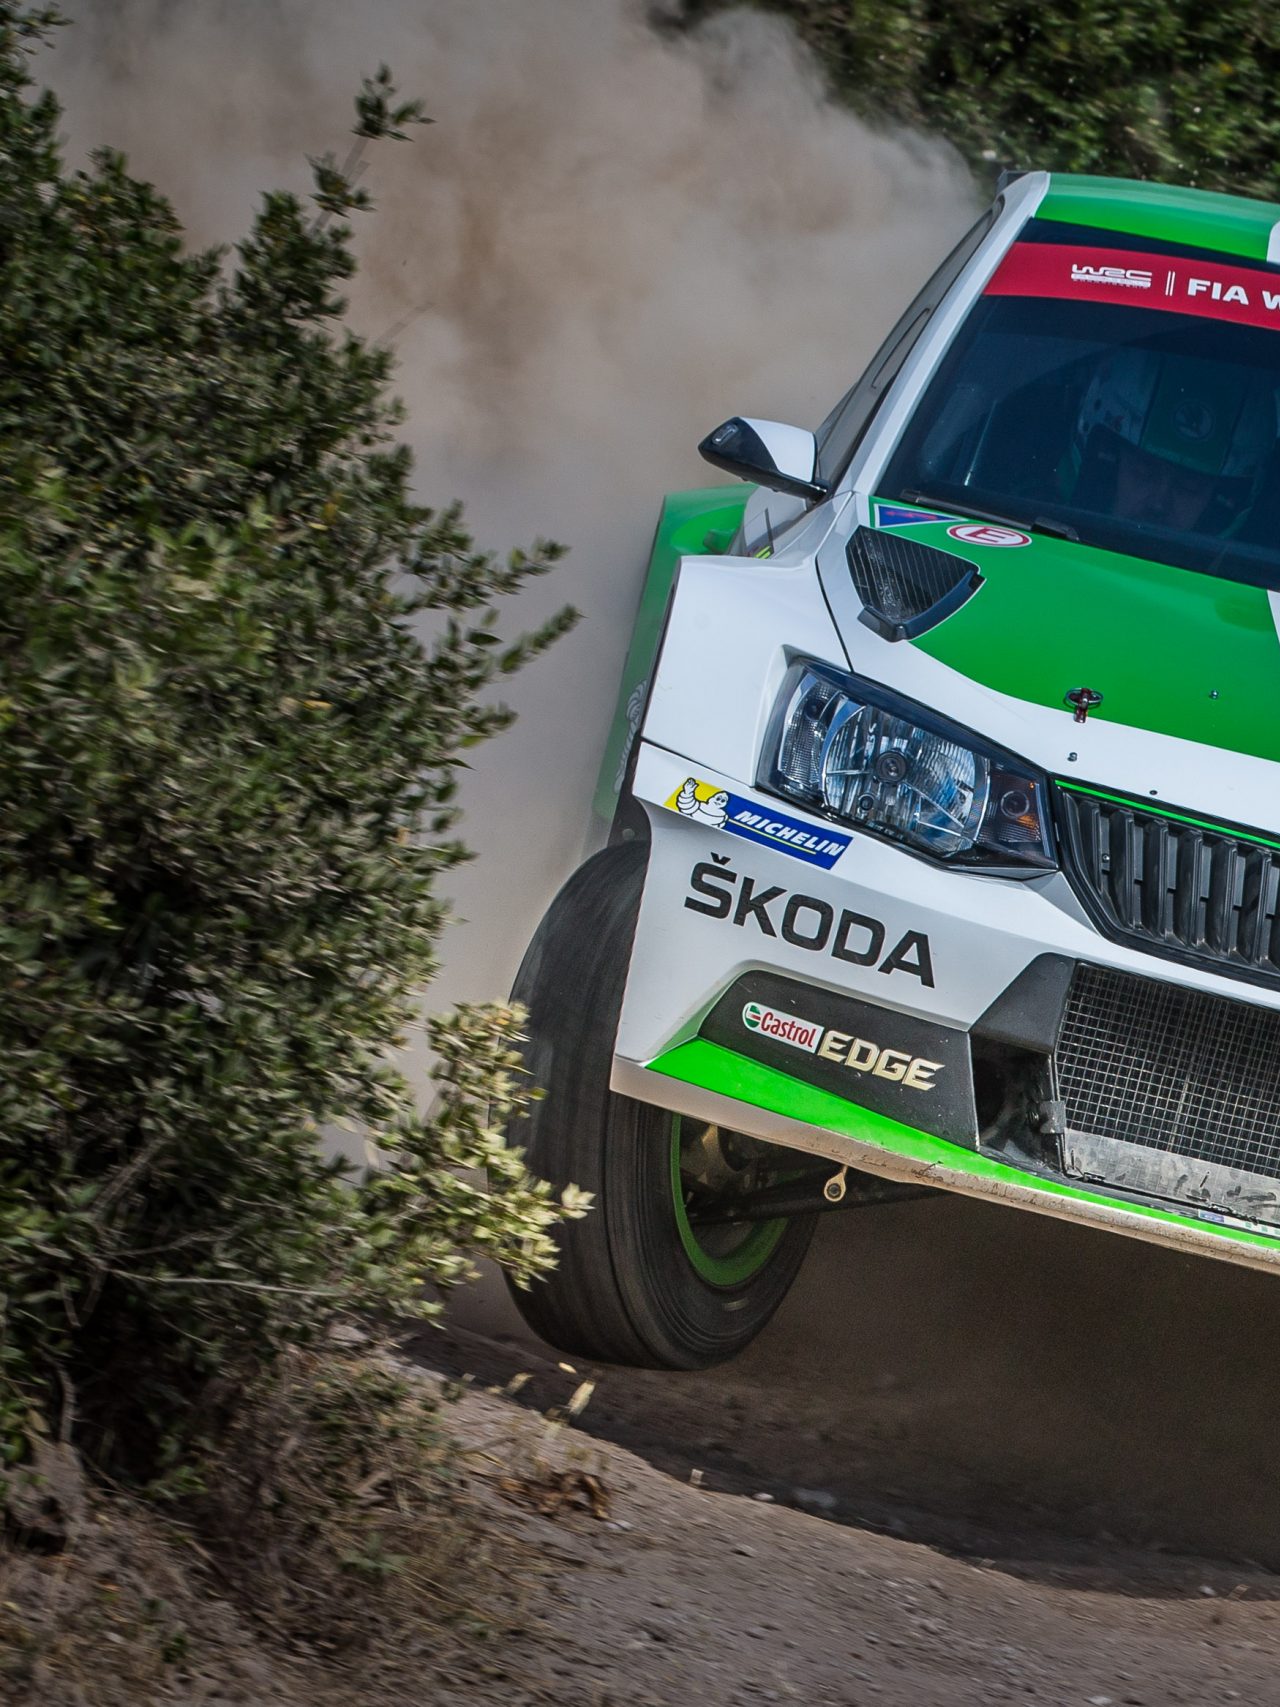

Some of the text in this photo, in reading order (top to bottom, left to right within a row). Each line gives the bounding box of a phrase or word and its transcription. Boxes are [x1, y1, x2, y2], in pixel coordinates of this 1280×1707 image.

[1071, 263, 1153, 281] WRC
[1187, 278, 1249, 305] FIA
[733, 810, 845, 857] MICHELIN
[684, 852, 935, 989] ŠKODA
[760, 1011, 946, 1091] Castrol EDGE
